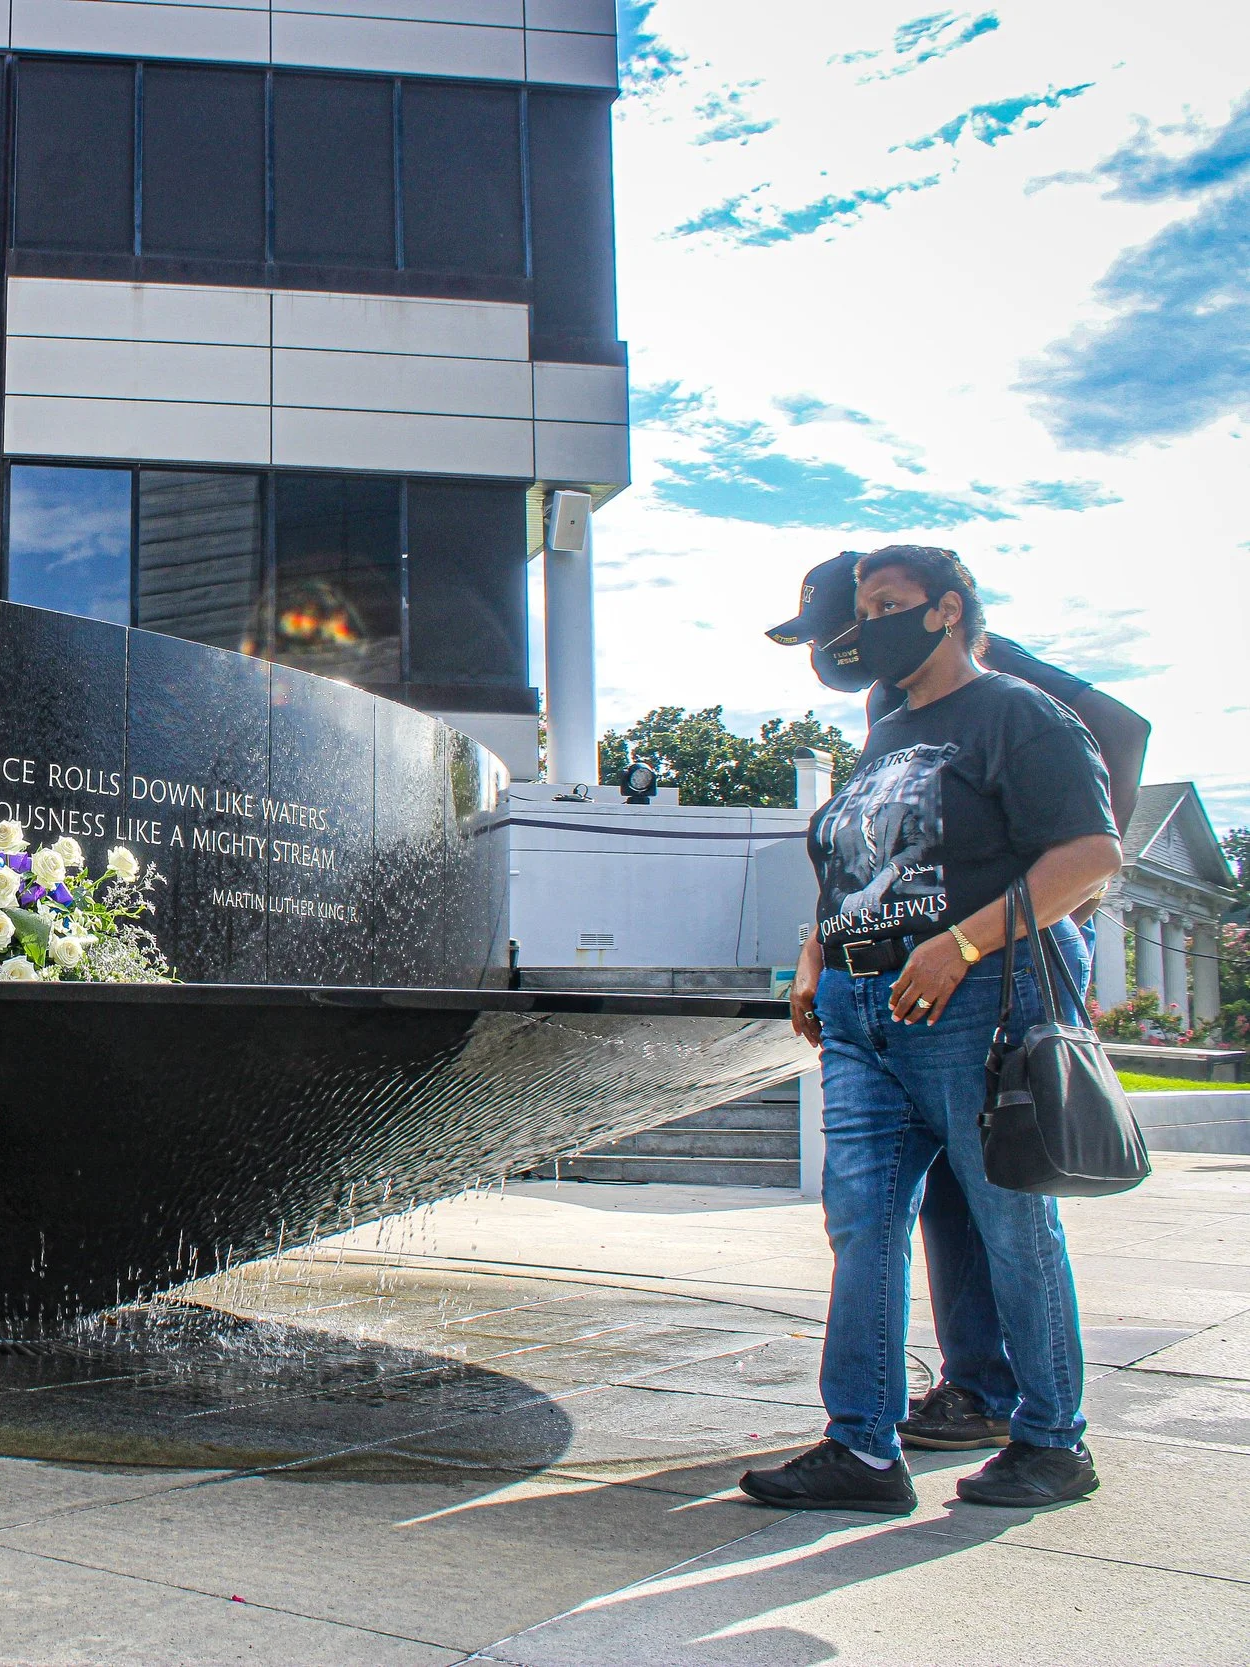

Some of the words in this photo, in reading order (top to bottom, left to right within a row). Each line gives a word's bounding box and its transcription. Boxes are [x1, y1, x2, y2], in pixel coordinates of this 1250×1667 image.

[837, 656, 859, 665] JESUS
[838, 648, 858, 658] LOVE
[49, 763, 121, 797] ROLLS
[132, 776, 205, 810] DOWN
[215, 789, 254, 819] LIKE
[116, 816, 162, 845] LIKE
[169, 824, 185, 849] A
[192, 827, 267, 859] MIGHTY
[272, 839, 337, 871] STREAM
[212, 887, 265, 912] MARTIN
[269, 896, 316, 917] LUTHER
[317, 901, 345, 921] KING
[820, 911, 854, 943] JOHN
[859, 907, 879, 926] R.
[882, 893, 948, 921] LEWIS
